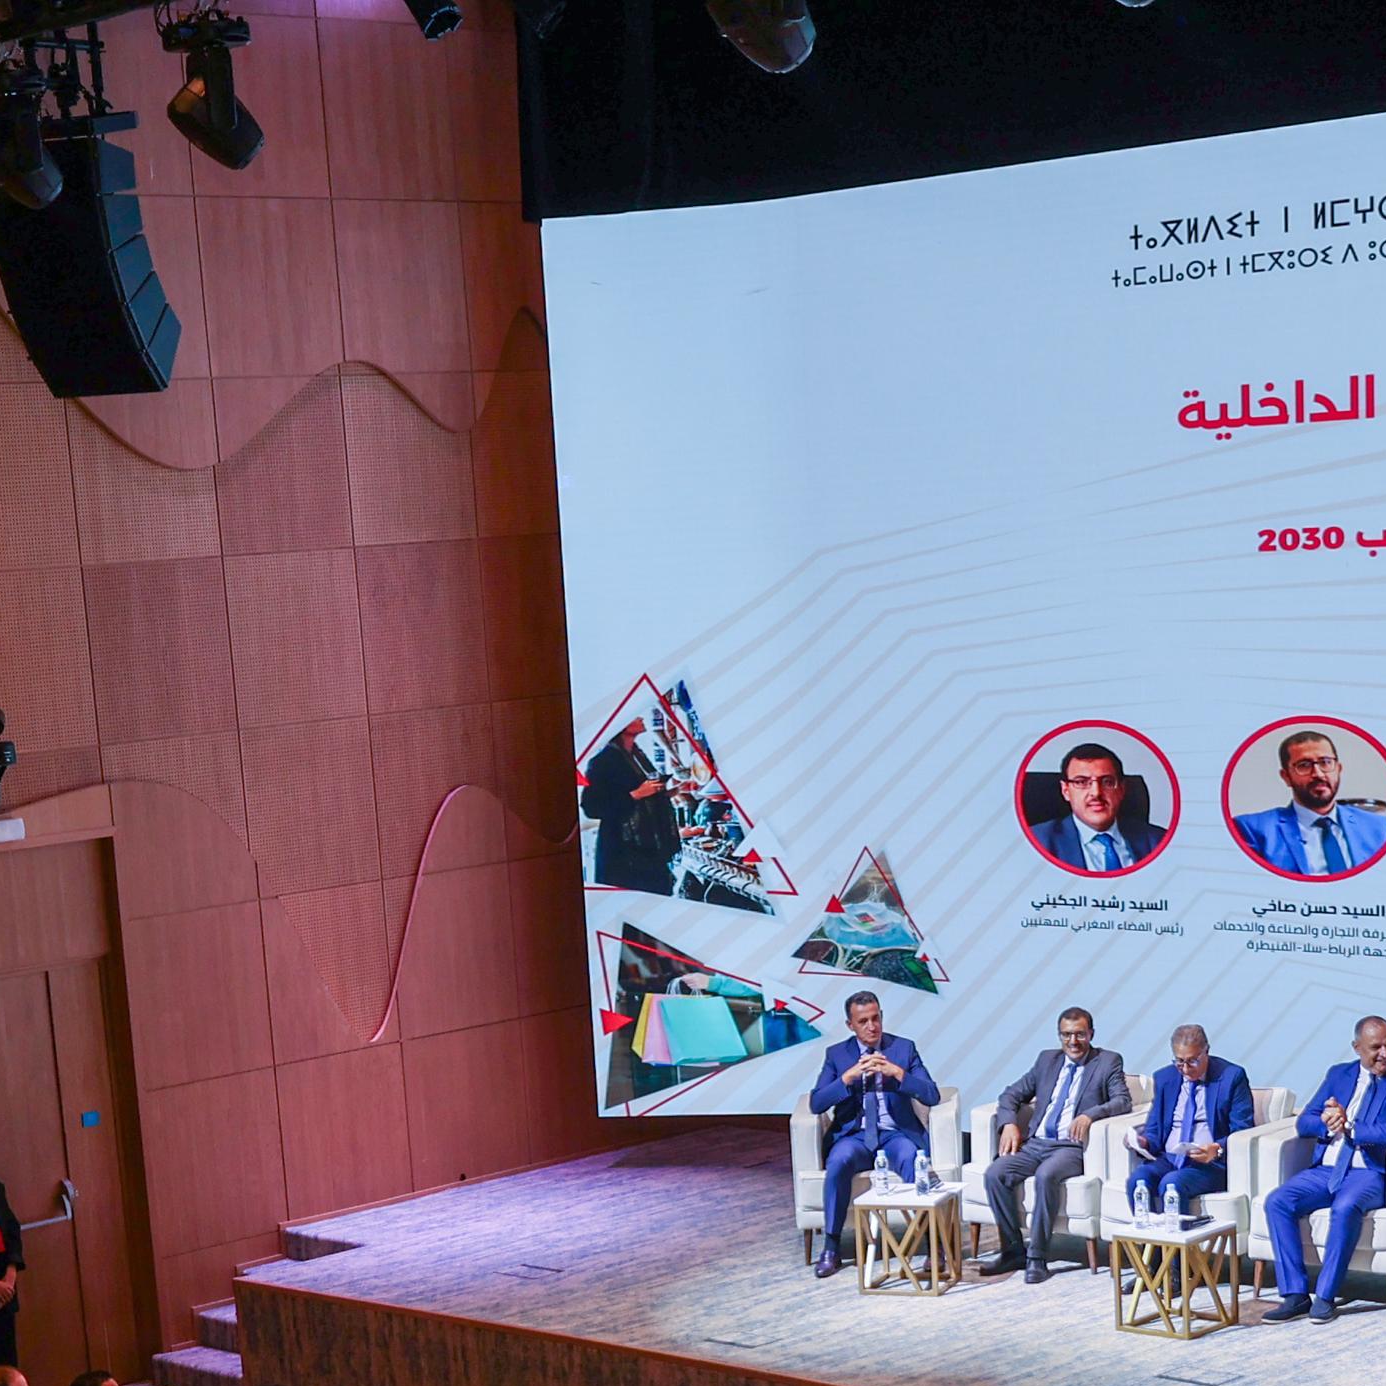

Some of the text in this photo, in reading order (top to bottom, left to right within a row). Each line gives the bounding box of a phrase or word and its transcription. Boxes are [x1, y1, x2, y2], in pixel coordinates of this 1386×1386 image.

[1178, 374, 1375, 440] الداخلية
[1258, 527, 1344, 551] 2030
[1031, 894, 1167, 912] السيد رشيد الجكيني
[1253, 900, 1385, 919] السيد حسن صاخي
[1021, 918, 1183, 936] رئيس الفضاء المغربي للمهنيين
[1214, 921, 1265, 935] والخدمات
[1268, 924, 1318, 938] والصناعة
[1322, 927, 1358, 939] التجارة
